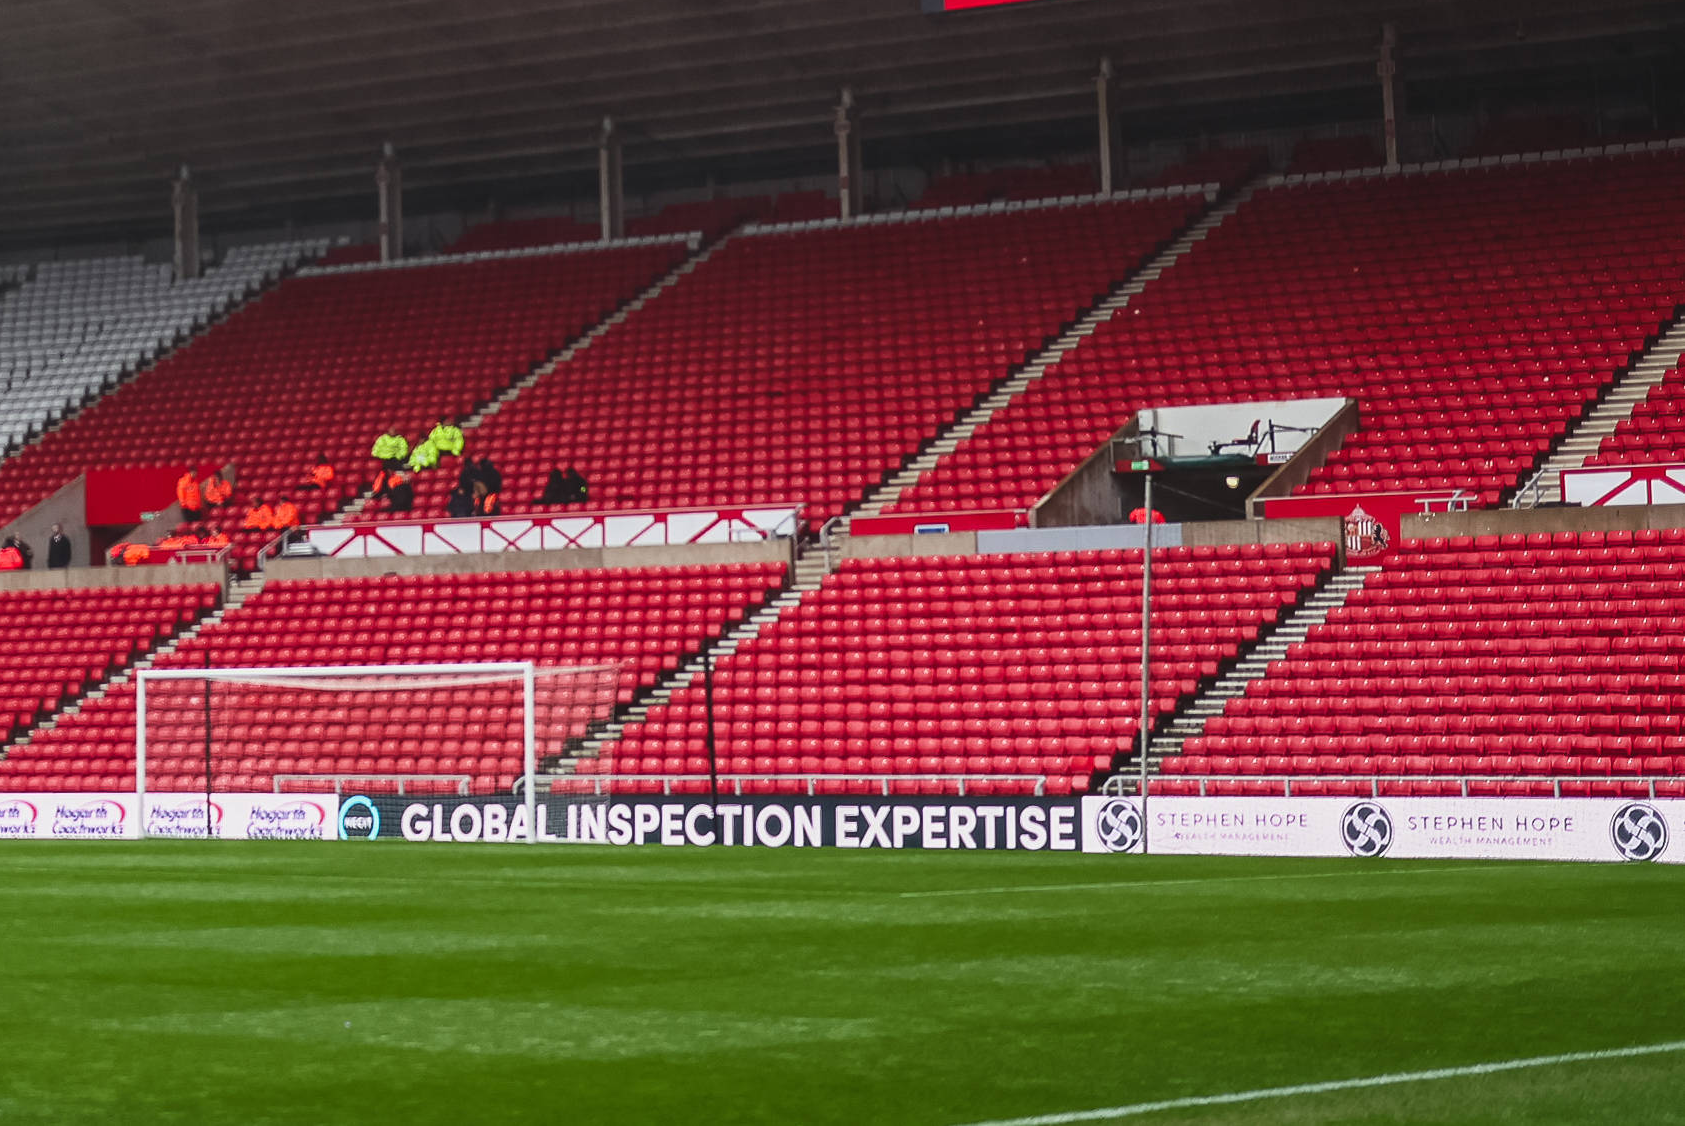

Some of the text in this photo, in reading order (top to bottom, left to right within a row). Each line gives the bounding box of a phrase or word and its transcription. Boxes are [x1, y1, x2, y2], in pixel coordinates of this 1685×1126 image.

[55, 805, 108, 822] Hogarth
[150, 804, 204, 822] Hogarth
[249, 804, 306, 823] Hogarth
[1156, 812, 1309, 828] STEPHEN HOPE
[400, 803, 1077, 851] GLOBAL INSPECTION EXPERTISE
[1408, 816, 1575, 832] STEPHEN HOPE
[1476, 837, 1553, 847] MANAGEMENT
